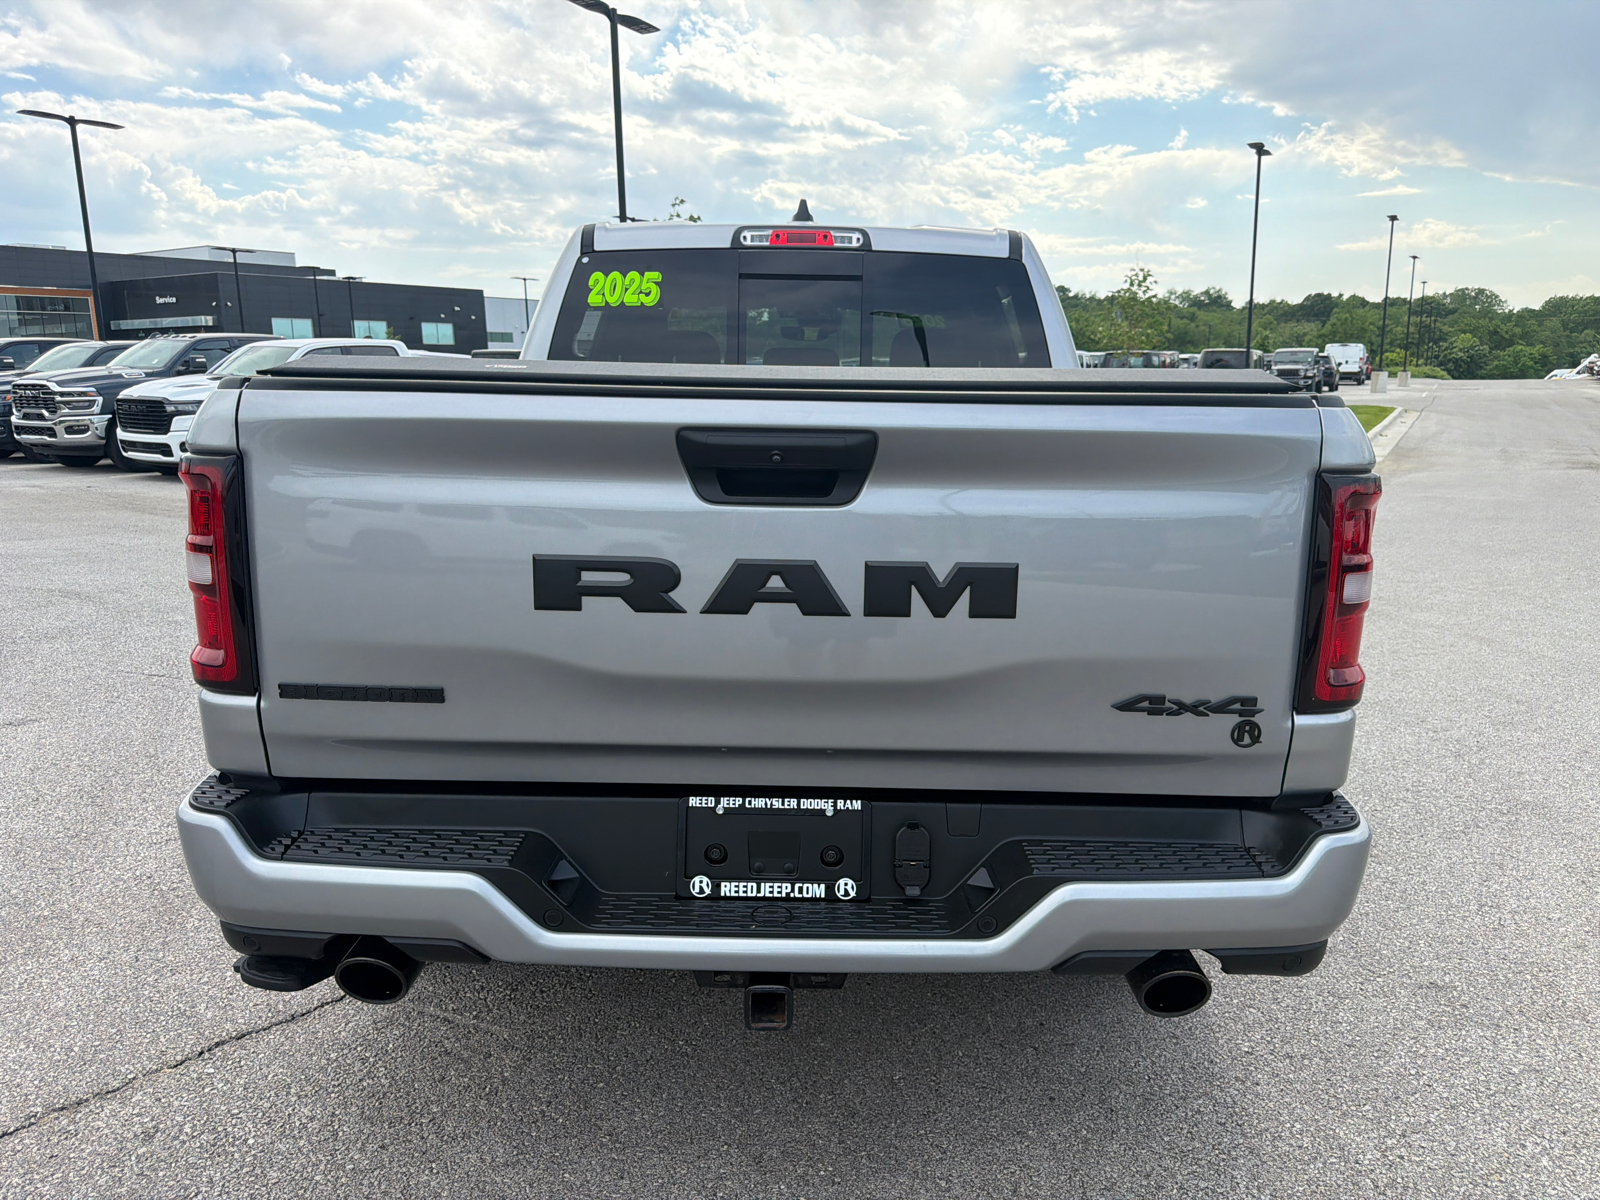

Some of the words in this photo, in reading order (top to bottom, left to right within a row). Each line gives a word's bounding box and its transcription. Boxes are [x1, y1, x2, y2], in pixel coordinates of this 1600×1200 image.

[588, 271, 662, 306] 2025
[155, 295, 177, 304] Service
[122, 404, 147, 412] RAM
[533, 554, 1019, 619] RAM
[688, 796, 715, 807] REED
[717, 797, 743, 808] JEEP
[745, 798, 797, 809] CHRYSLER
[800, 798, 834, 810] DODGE
[836, 800, 862, 810] RAM
[720, 882, 826, 898] REEDJEEP.COM
